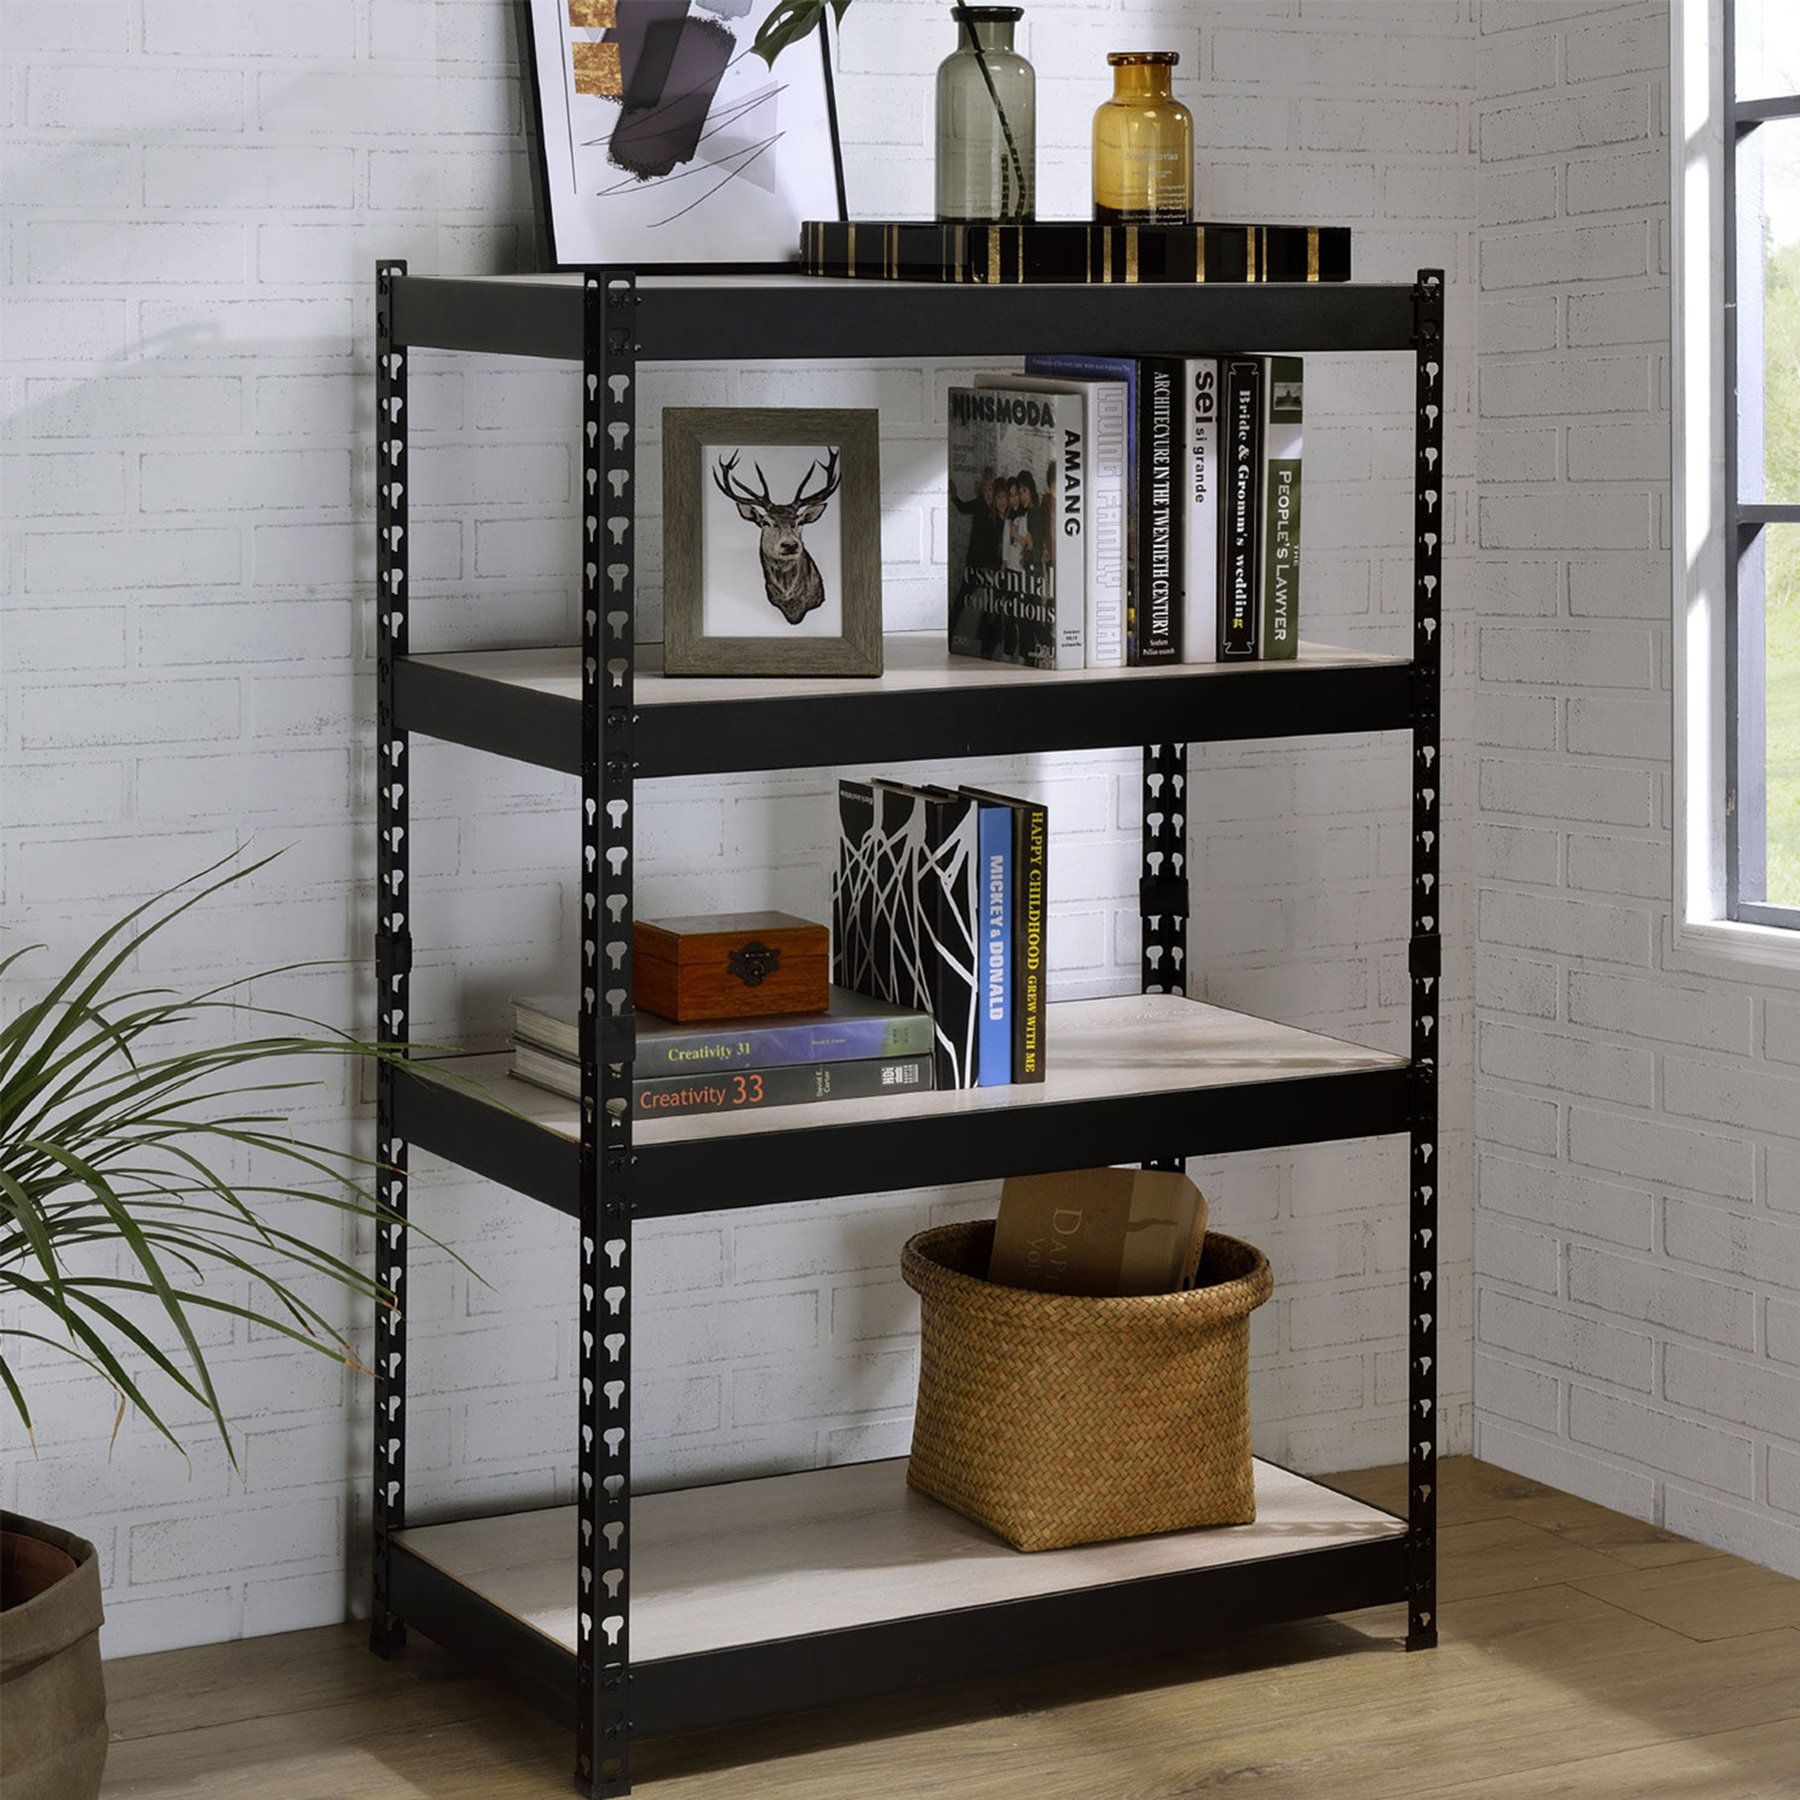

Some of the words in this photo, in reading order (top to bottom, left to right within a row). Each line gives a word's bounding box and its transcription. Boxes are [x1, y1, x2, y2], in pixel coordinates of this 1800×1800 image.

[1097, 387, 1124, 479] LOVING
[1238, 390, 1251, 440] Bride
[1154, 466, 1170, 479] IN
[1193, 446, 1207, 503] grande
[1238, 444, 1251, 461] &
[1063, 429, 1082, 537] AMANG
[1153, 481, 1170, 506] THE
[1096, 489, 1123, 588] FAMILY
[1153, 508, 1170, 578] TWENTIETH
[1277, 471, 1292, 559] PEOPLE'S
[964, 565, 1055, 598] essential
[964, 588, 1056, 624] collections
[1152, 580, 1169, 636] CENTURY
[1233, 554, 1247, 629] wedding
[1274, 564, 1291, 641] LAWYER
[1097, 600, 1123, 661] MAN
[1030, 811, 1044, 865] HAPPY
[990, 855, 1004, 926] MICKEY
[1027, 869, 1043, 970] CHILDHOOD
[989, 941, 1004, 1020] DONALD
[1026, 975, 1037, 1012] GREW
[668, 1044, 732, 1062] Creativity
[737, 1042, 751, 1056] 31
[1026, 1015, 1036, 1050] WITH
[1025, 1053, 1035, 1073] ME
[640, 1086, 726, 1109] Creativity
[732, 1074, 765, 1104] 33
